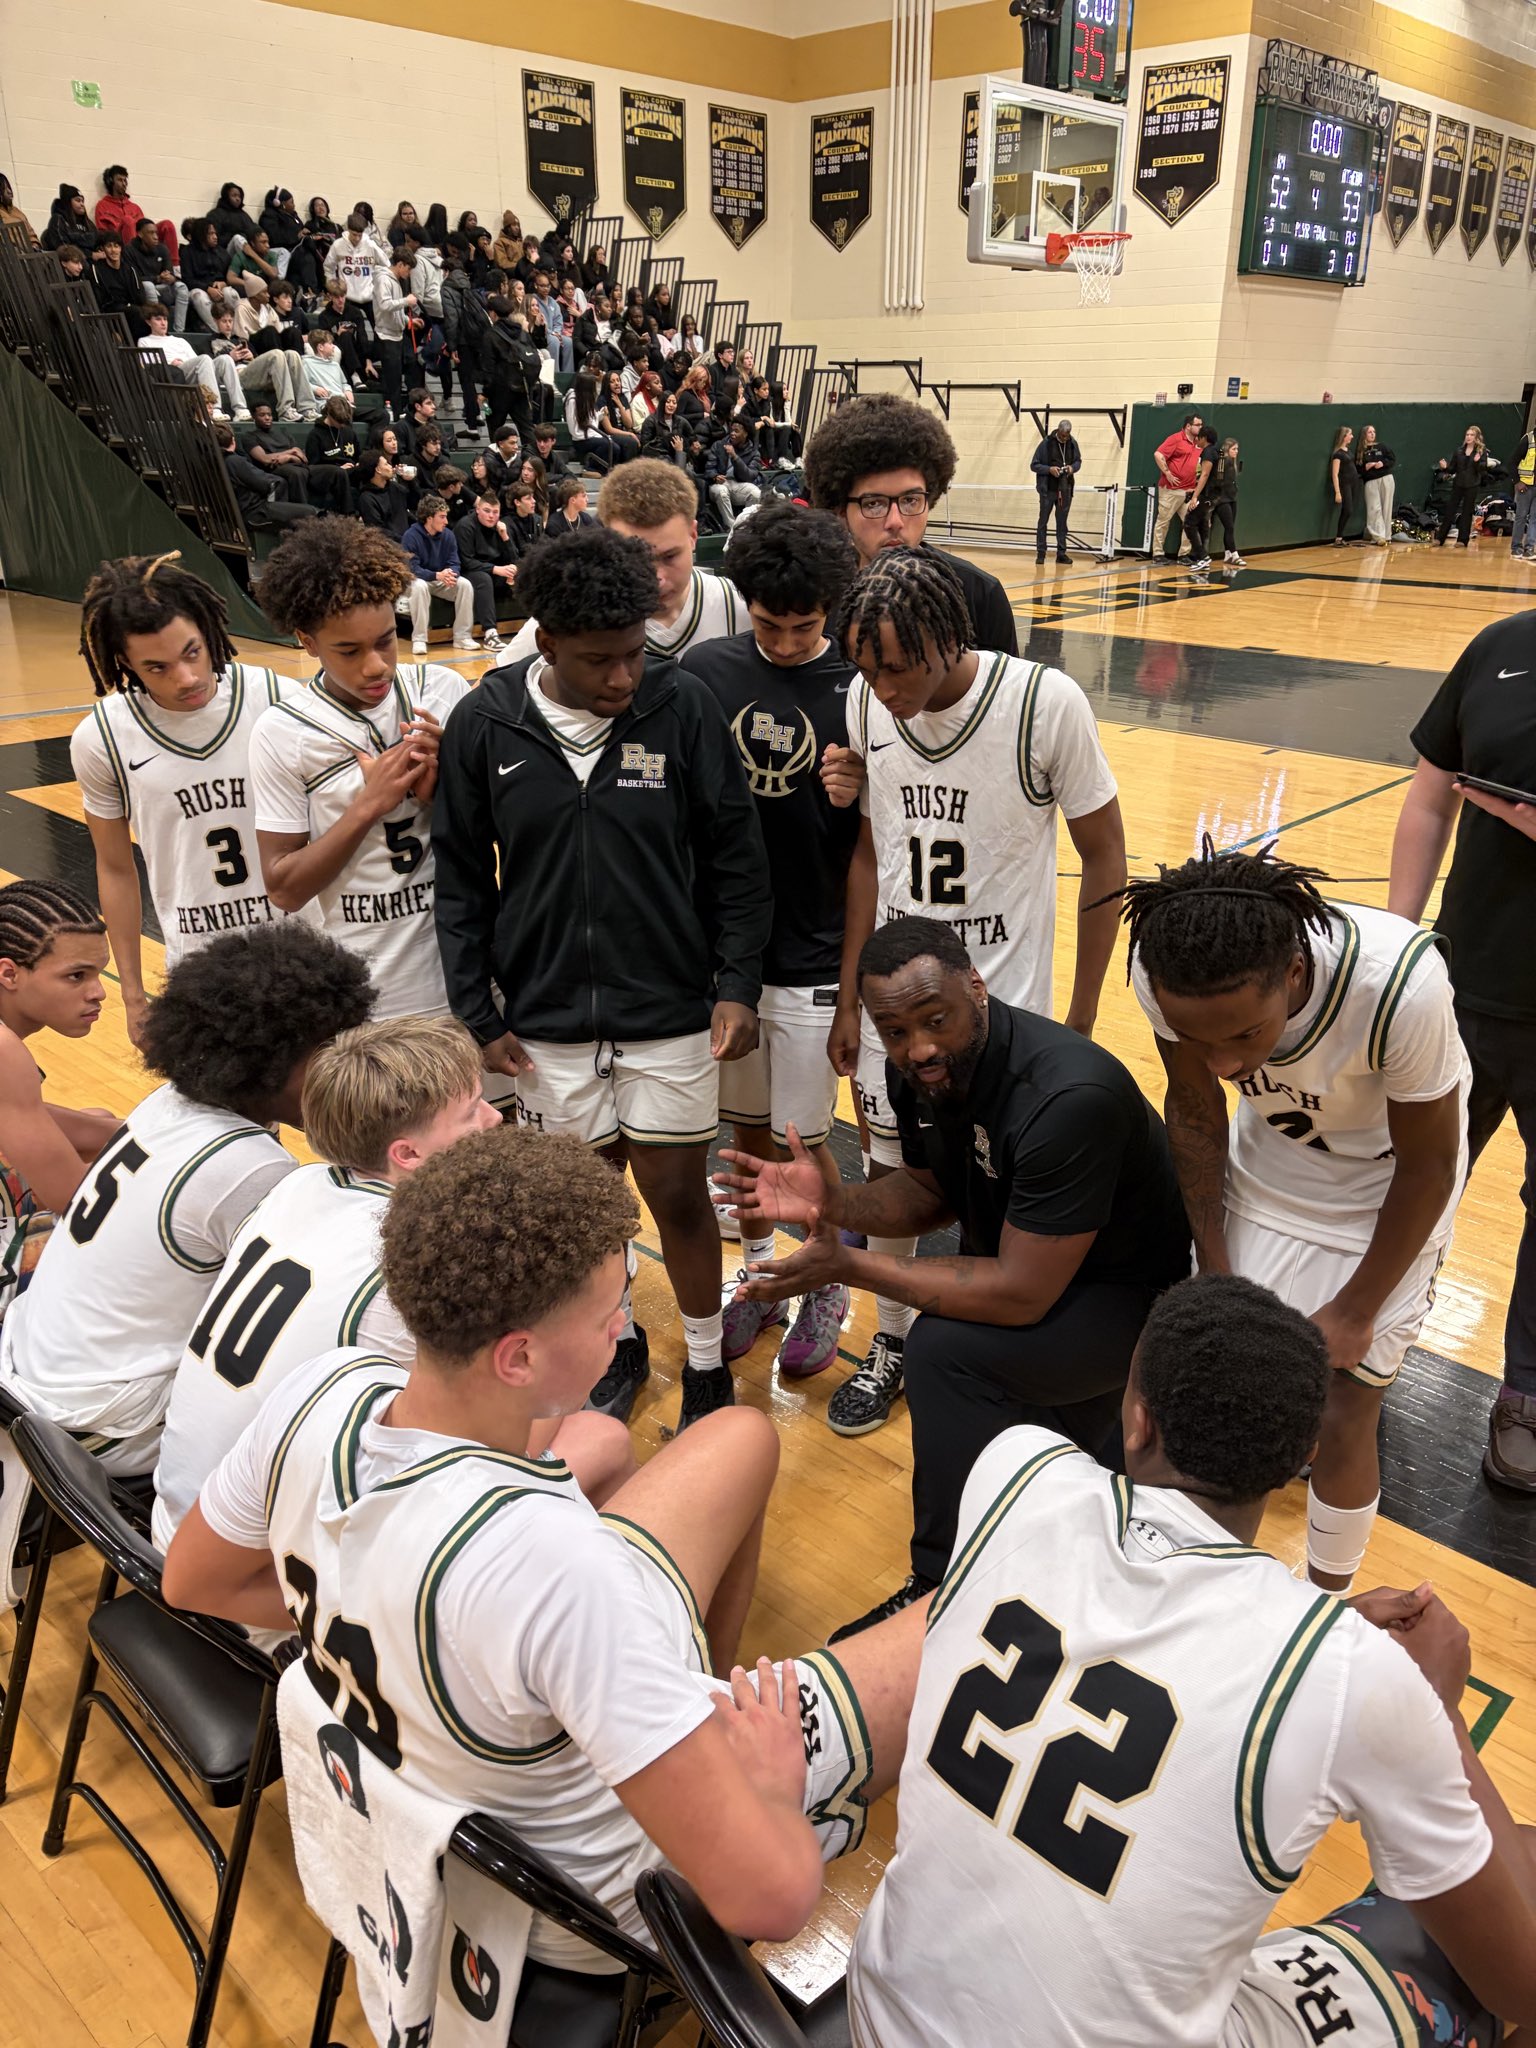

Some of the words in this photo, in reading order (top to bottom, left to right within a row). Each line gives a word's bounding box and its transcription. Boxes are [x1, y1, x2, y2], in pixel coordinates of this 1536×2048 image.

[1073, 22, 1105, 82] 35
[532, 75, 554, 85] ROYAL
[1148, 67, 1224, 85] BASEBALL
[1156, 68, 1181, 76] ROYAL
[1184, 62, 1216, 73] COMETS
[1146, 76, 1224, 112] CHAMPIONS
[527, 88, 591, 125] CHAMPIONS
[542, 112, 578, 124] COUNTY
[635, 100, 672, 114] FOOTBALL
[1163, 101, 1203, 112] COUNTY
[1163, 113, 1180, 123] 1961
[1182, 110, 1200, 121] 1963
[1202, 108, 1219, 119] 1964
[624, 106, 682, 139] CHAMPIONS
[639, 129, 669, 138] COUNTY
[721, 115, 755, 128] FOOTBALL
[833, 120, 851, 129] GOLF
[1052, 126, 1068, 137] 2005
[1162, 124, 1179, 135] 1970
[1181, 121, 1199, 132] 1979
[1201, 119, 1219, 131] 2007
[712, 121, 763, 152] CHAMPIONS
[724, 143, 752, 152] COUNTY
[815, 125, 870, 155] CHAMPIONS
[1310, 119, 1343, 159] 8:00
[540, 163, 576, 174] SECTION
[1061, 165, 1098, 175] SECTION
[1140, 168, 1157, 178] 1990
[1154, 156, 1194, 166] SECTION
[637, 177, 667, 187] SECTION
[1309, 169, 1326, 183] PERIOD
[1269, 174, 1291, 210] 52
[1311, 188, 1320, 211] 4
[1342, 190, 1361, 223] 53
[1262, 239, 1272, 266] 0
[1280, 243, 1288, 267] 4
[1327, 249, 1336, 274] 3
[1344, 251, 1353, 276] 0
[750, 711, 795, 754] RH
[621, 743, 666, 780] RH
[616, 778, 667, 789] BASKETBALL
[174, 776, 247, 821] RUSH
[900, 784, 969, 825] RUSH
[204, 824, 251, 889] 3
[382, 815, 425, 877] 5
[906, 834, 968, 908] 12
[188, 1233, 315, 1393] 10
[923, 1593, 1184, 1905] 22
[1273, 1944, 1356, 2047] RH
